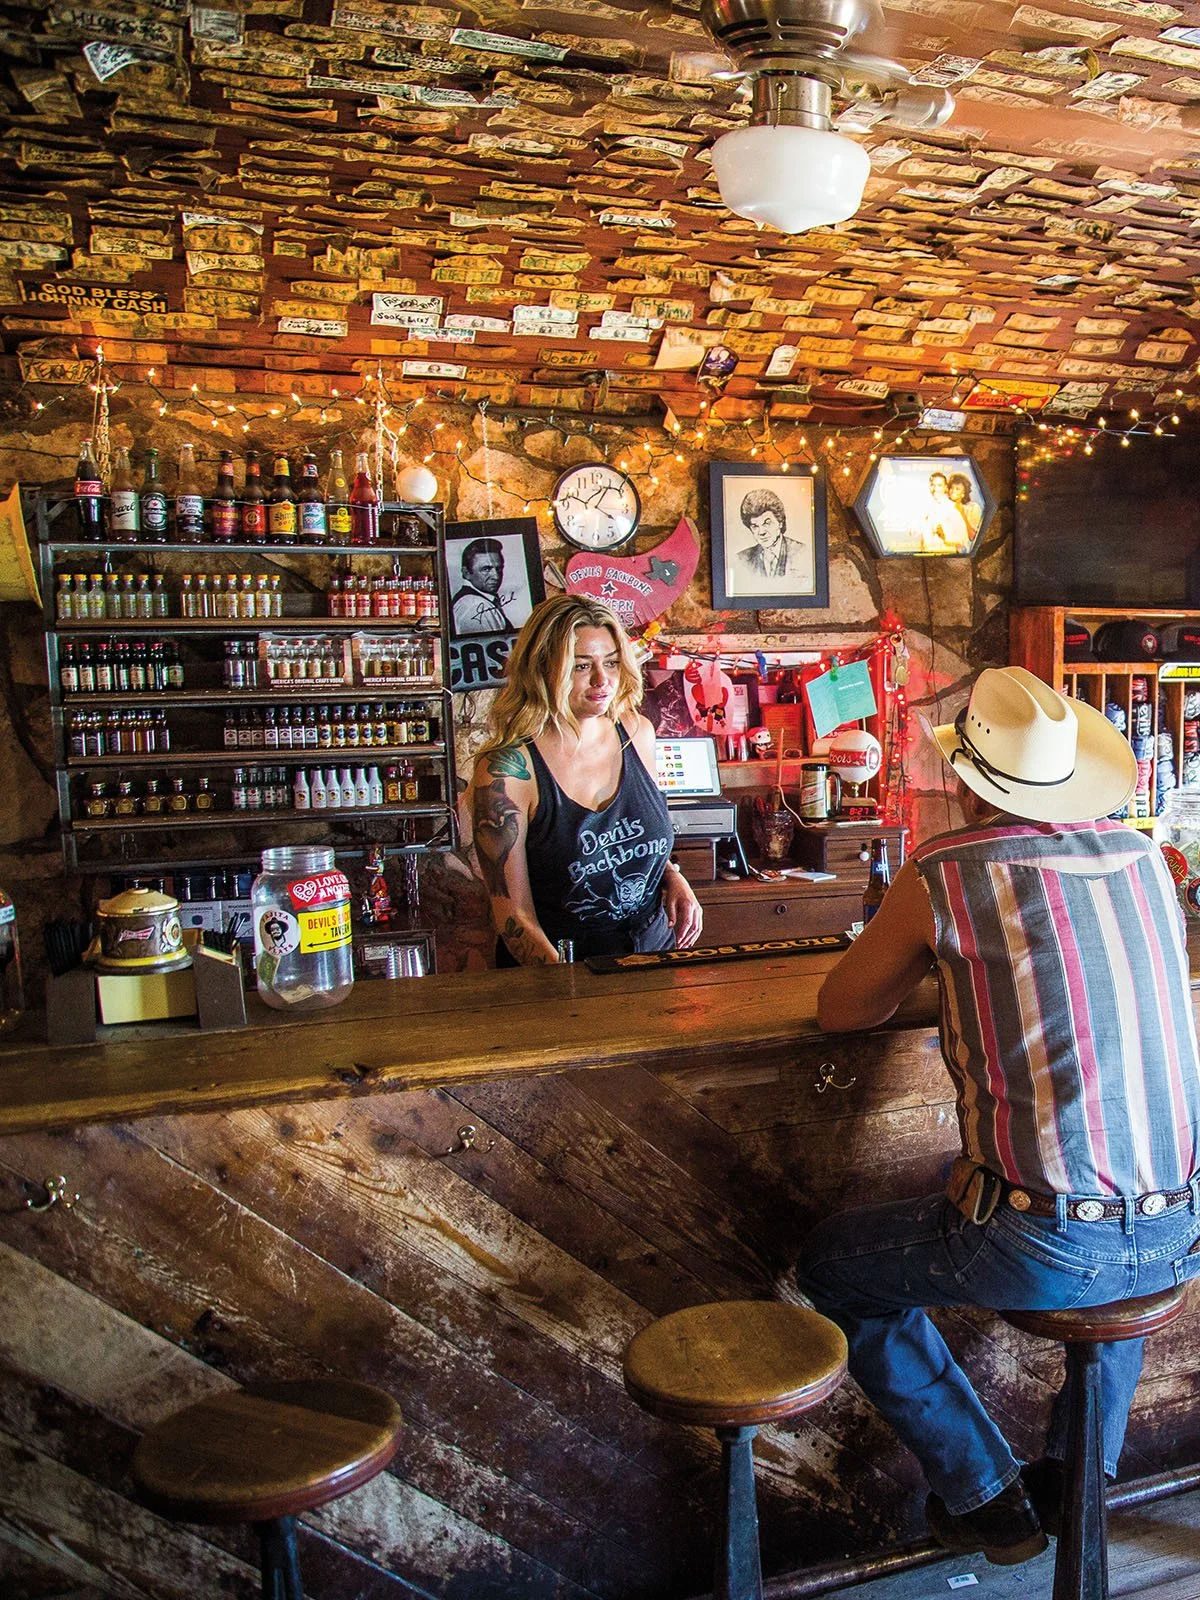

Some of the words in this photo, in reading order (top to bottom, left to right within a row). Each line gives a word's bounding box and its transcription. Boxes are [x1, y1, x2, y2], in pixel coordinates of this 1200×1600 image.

[42, 283, 89, 297] GOD
[92, 287, 152, 300] BLESS
[29, 291, 108, 308] JOHNNY
[112, 299, 167, 313] CASH
[578, 478, 586, 489] 11
[562, 500, 570, 511] 9
[622, 504, 629, 514] 3
[567, 515, 575, 527] 8
[607, 526, 615, 537] 5
[605, 567, 653, 596] BACKBONE
[450, 639, 517, 685] CAS
[581, 817, 645, 855] Devils
[567, 837, 668, 884] Backbone
[316, 875, 341, 887] LOVE
[308, 915, 337, 930] DEVIL'S
[331, 924, 350, 938] TAVERN
[671, 947, 737, 960] DOS
[741, 936, 841, 952] EQUIS
